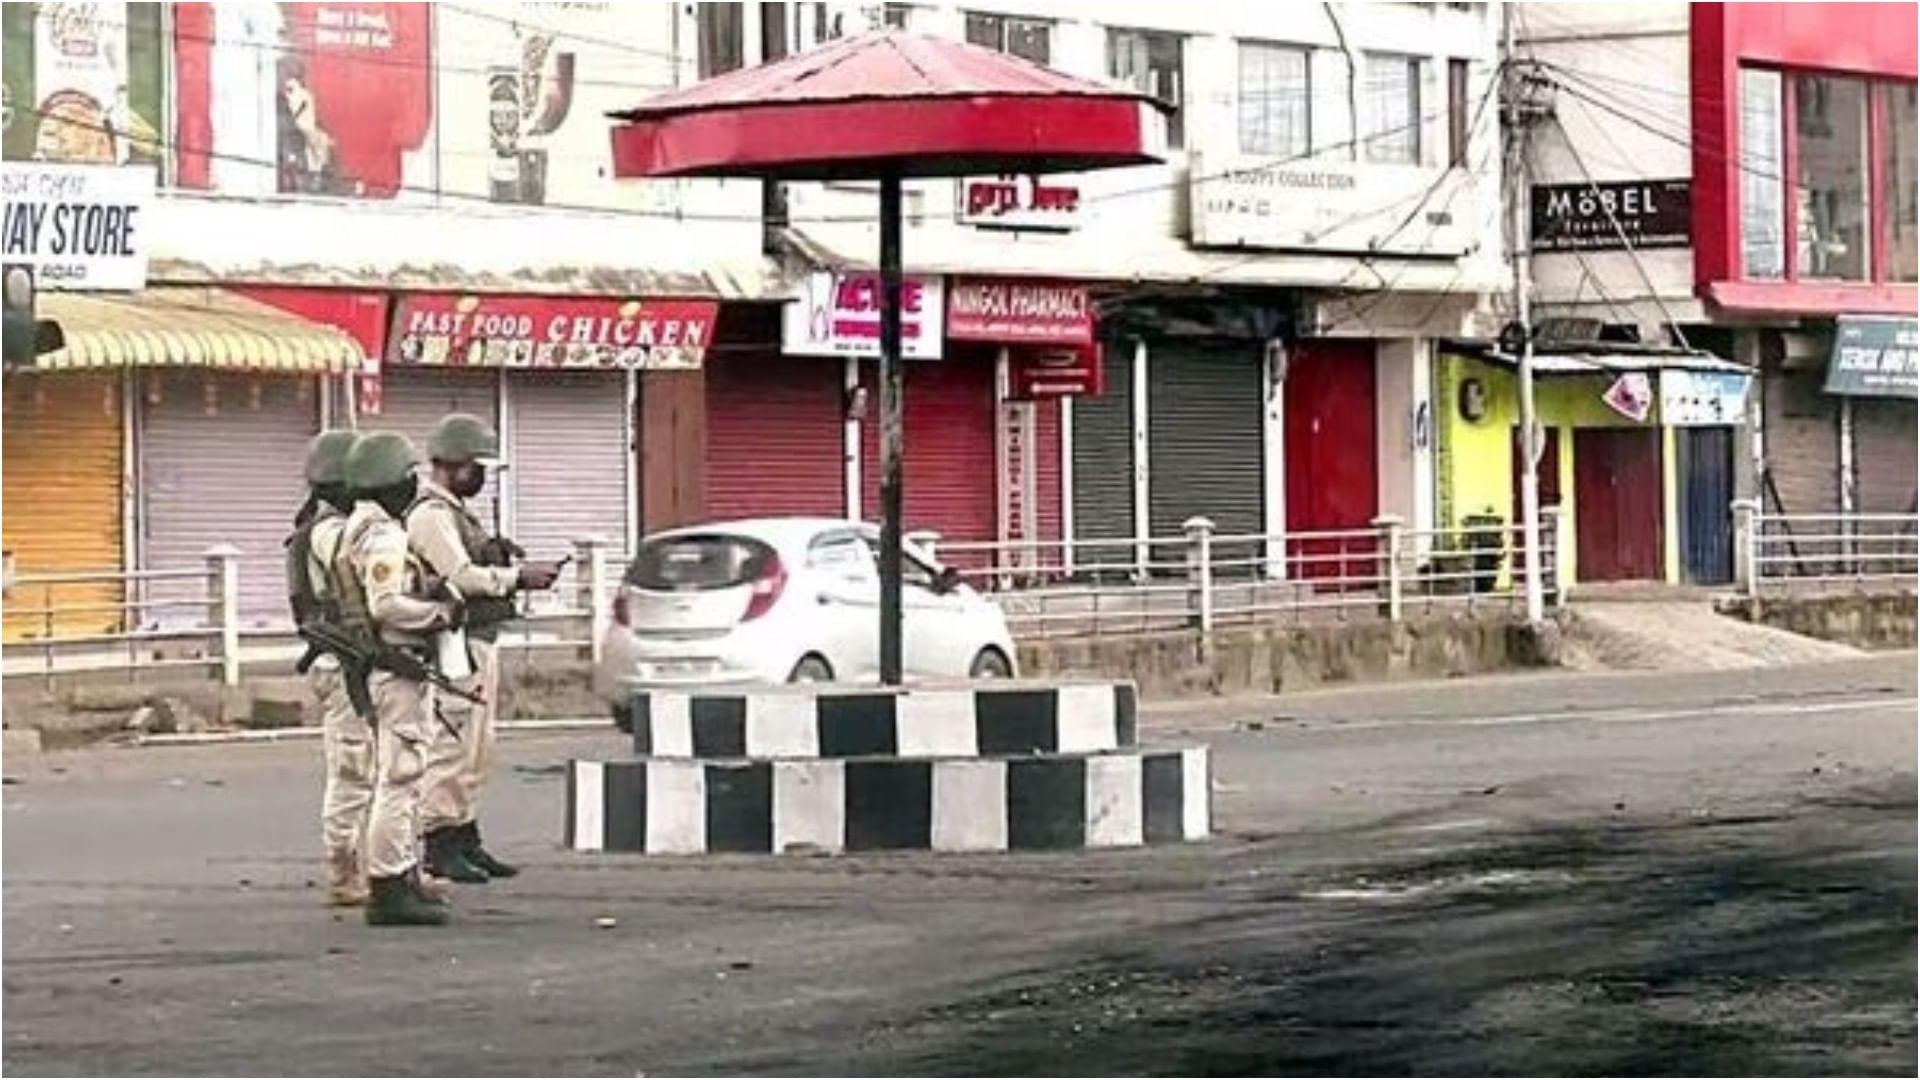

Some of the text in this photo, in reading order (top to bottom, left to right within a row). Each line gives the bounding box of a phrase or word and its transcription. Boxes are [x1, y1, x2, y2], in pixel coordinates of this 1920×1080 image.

[50, 202, 140, 256] STORE
[40, 263, 87, 280] ROAD
[1010, 285, 1087, 319] PHARMACY
[409, 310, 707, 346] FAST FOOD CHICKEN
